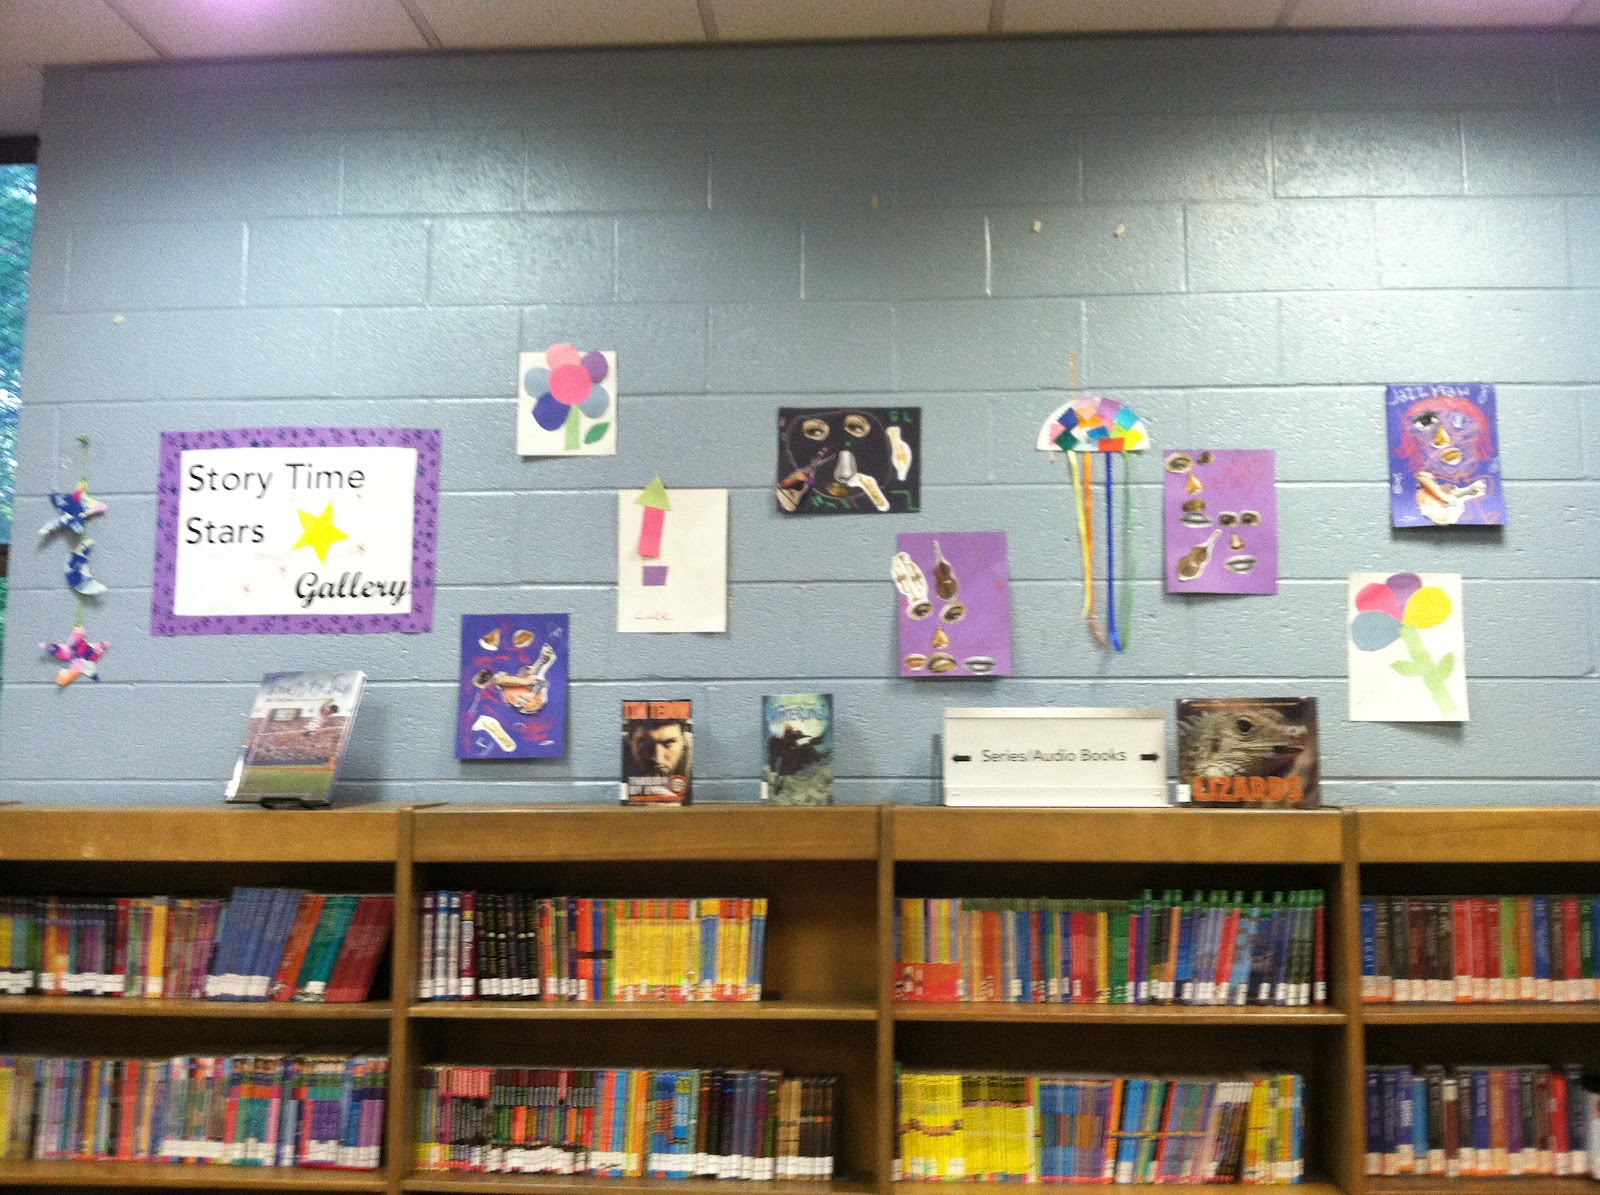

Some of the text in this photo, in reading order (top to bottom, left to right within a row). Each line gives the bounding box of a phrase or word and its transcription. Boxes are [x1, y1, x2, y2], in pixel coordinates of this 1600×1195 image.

[187, 462, 366, 499] Story Time
[185, 516, 265, 544] Stars
[294, 571, 411, 608] Gallery
[1080, 748, 1127, 762] Books
[1193, 774, 1305, 803] LIZARDS
